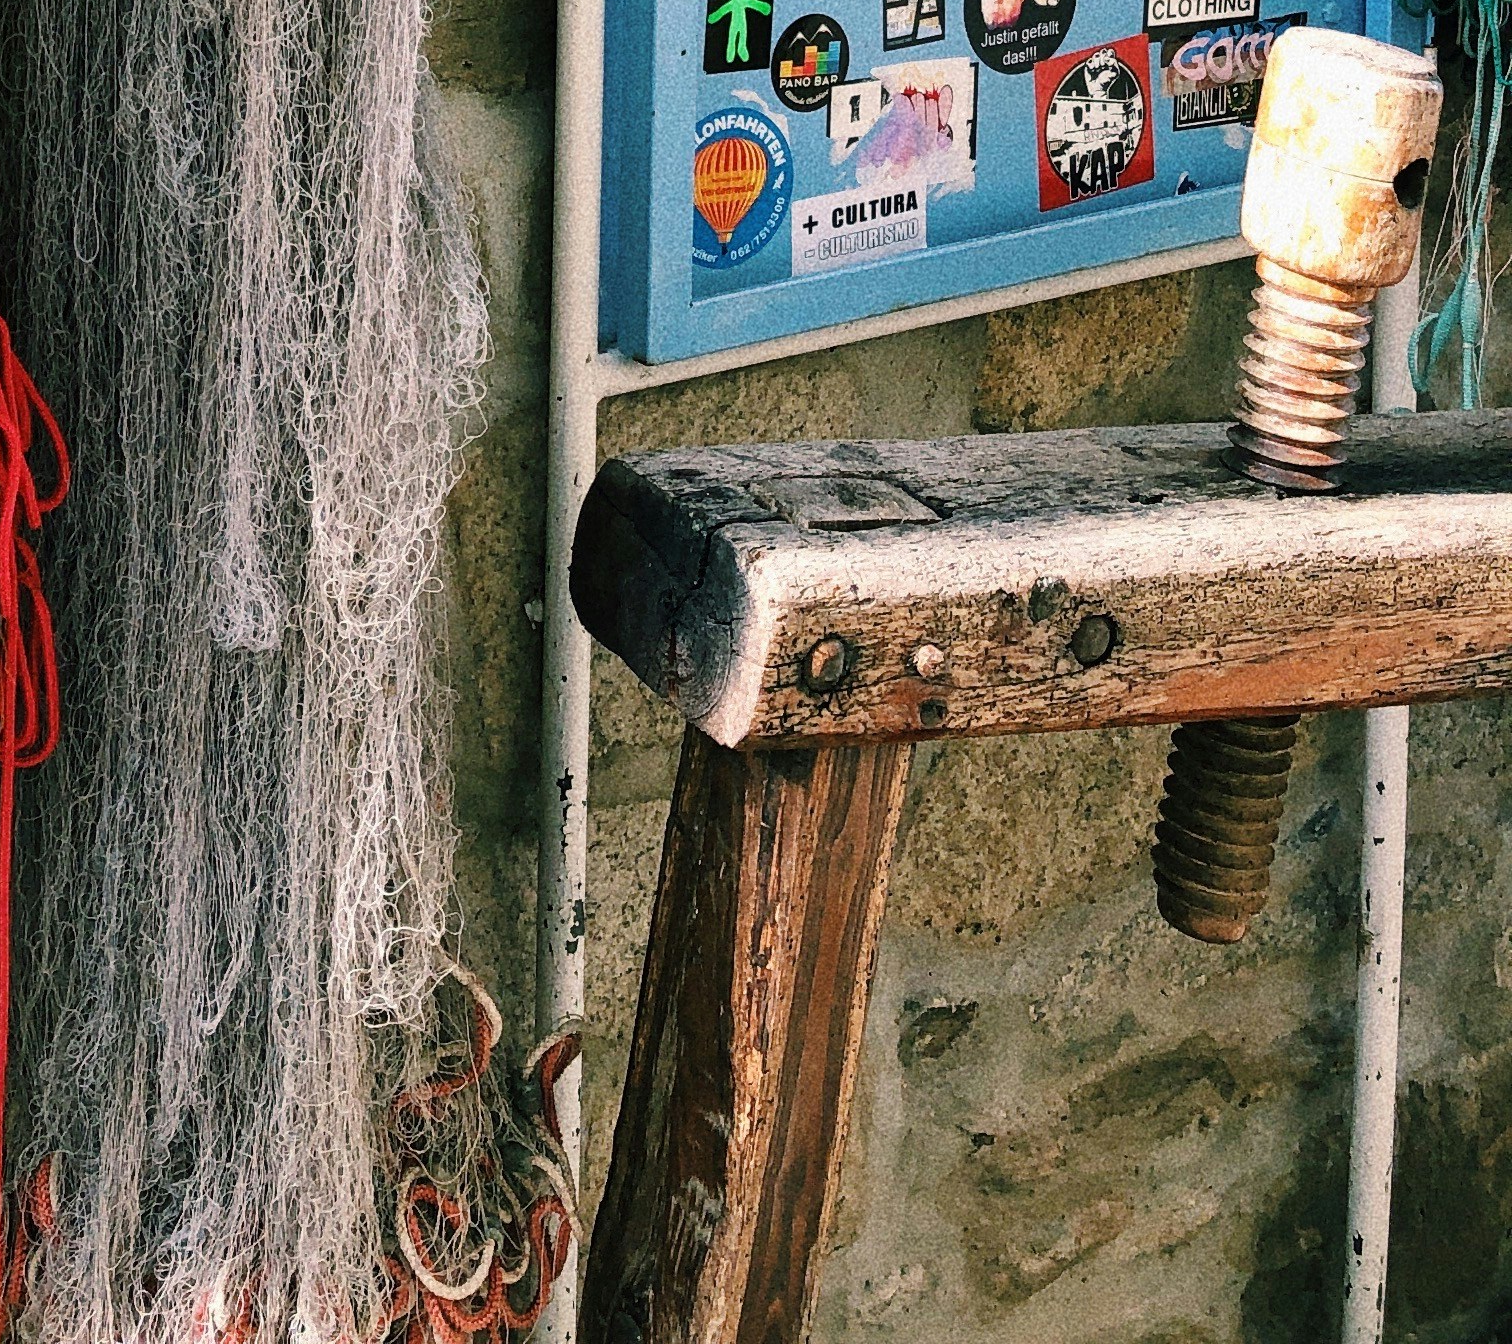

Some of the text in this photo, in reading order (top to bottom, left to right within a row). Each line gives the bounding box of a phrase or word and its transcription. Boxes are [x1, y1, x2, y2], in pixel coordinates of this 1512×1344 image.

[981, 20, 1060, 48] Justin gefällt
[1002, 45, 1038, 67] das!!!
[779, 74, 838, 89] PANO BAR
[1069, 141, 1127, 201] KAP
[831, 190, 918, 229] CULTURA
[818, 217, 920, 261] CULTURISMO
